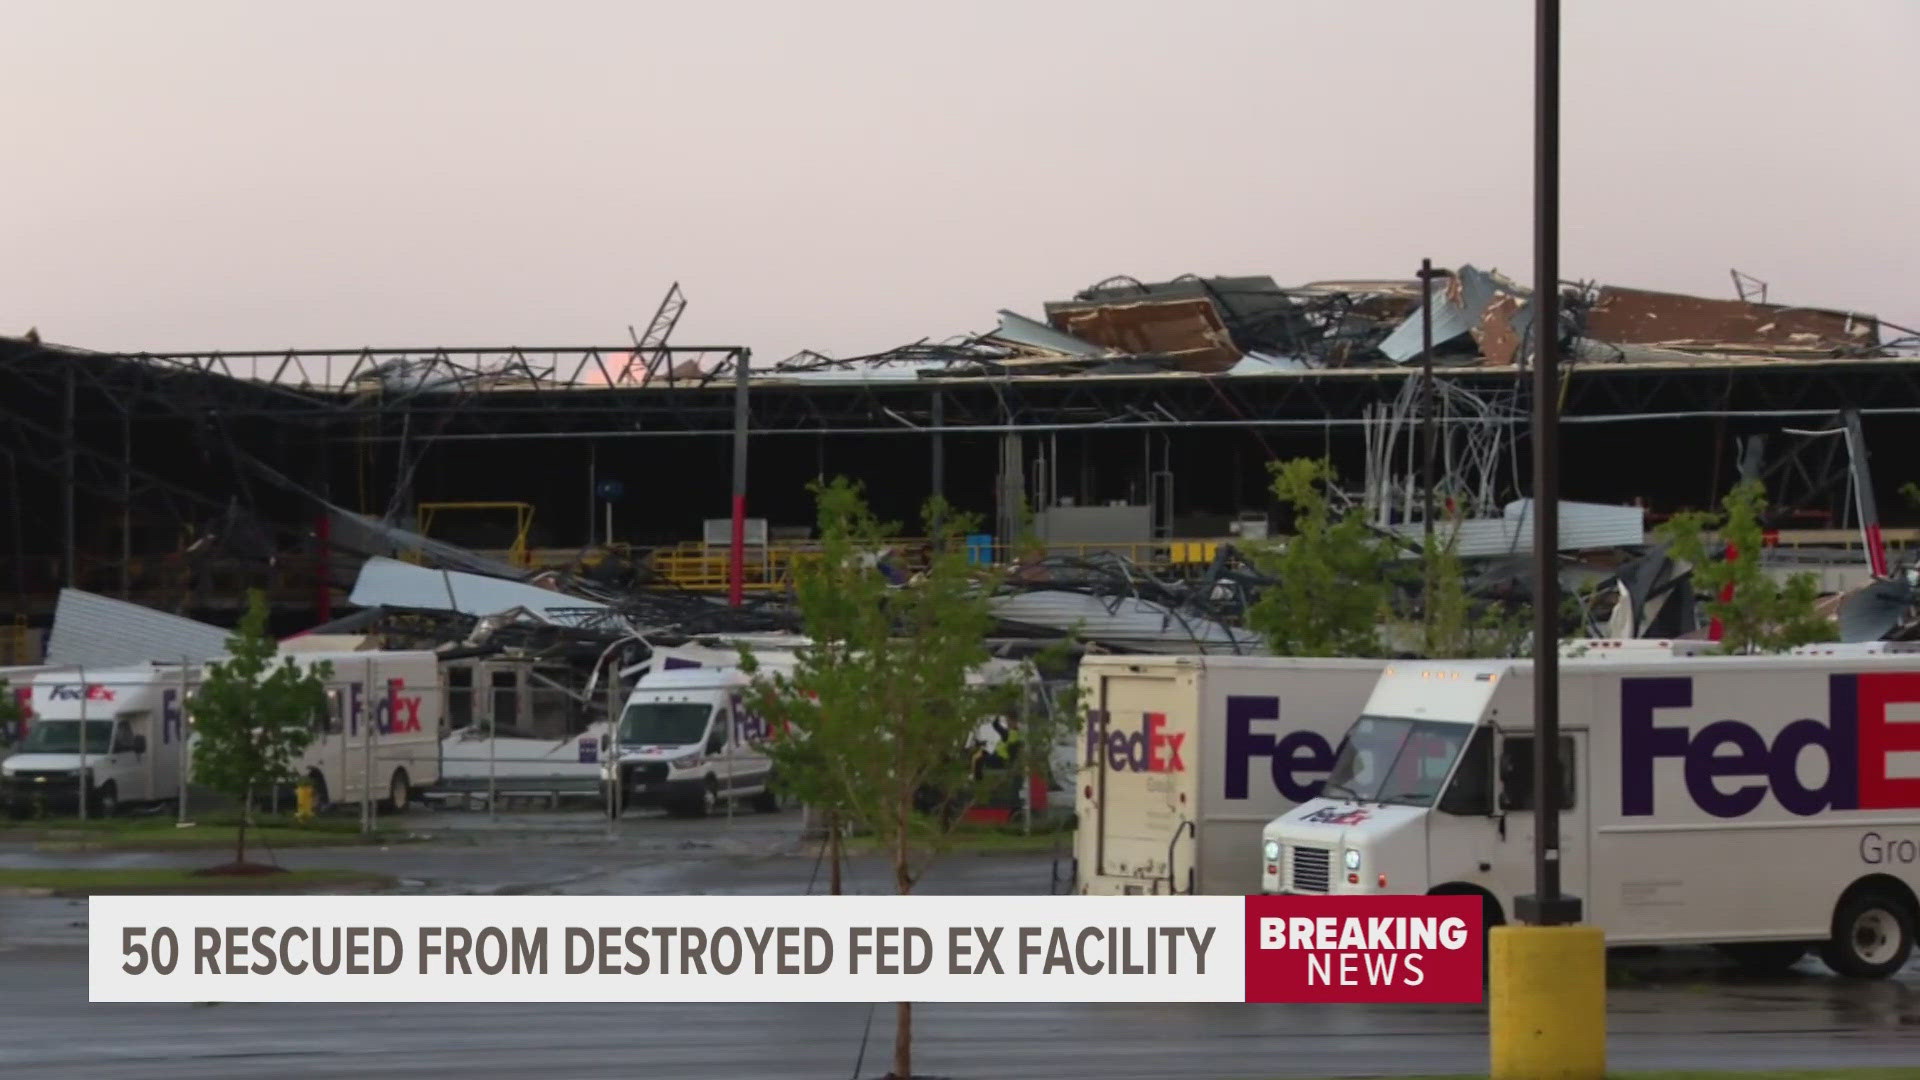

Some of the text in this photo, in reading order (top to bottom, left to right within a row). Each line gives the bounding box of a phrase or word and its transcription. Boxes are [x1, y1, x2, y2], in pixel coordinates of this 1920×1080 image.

[350, 678, 422, 737] FdEx
[1086, 710, 1186, 773] FedEx
[1225, 695, 1348, 803] Fe
[1859, 832, 1920, 864] Gro
